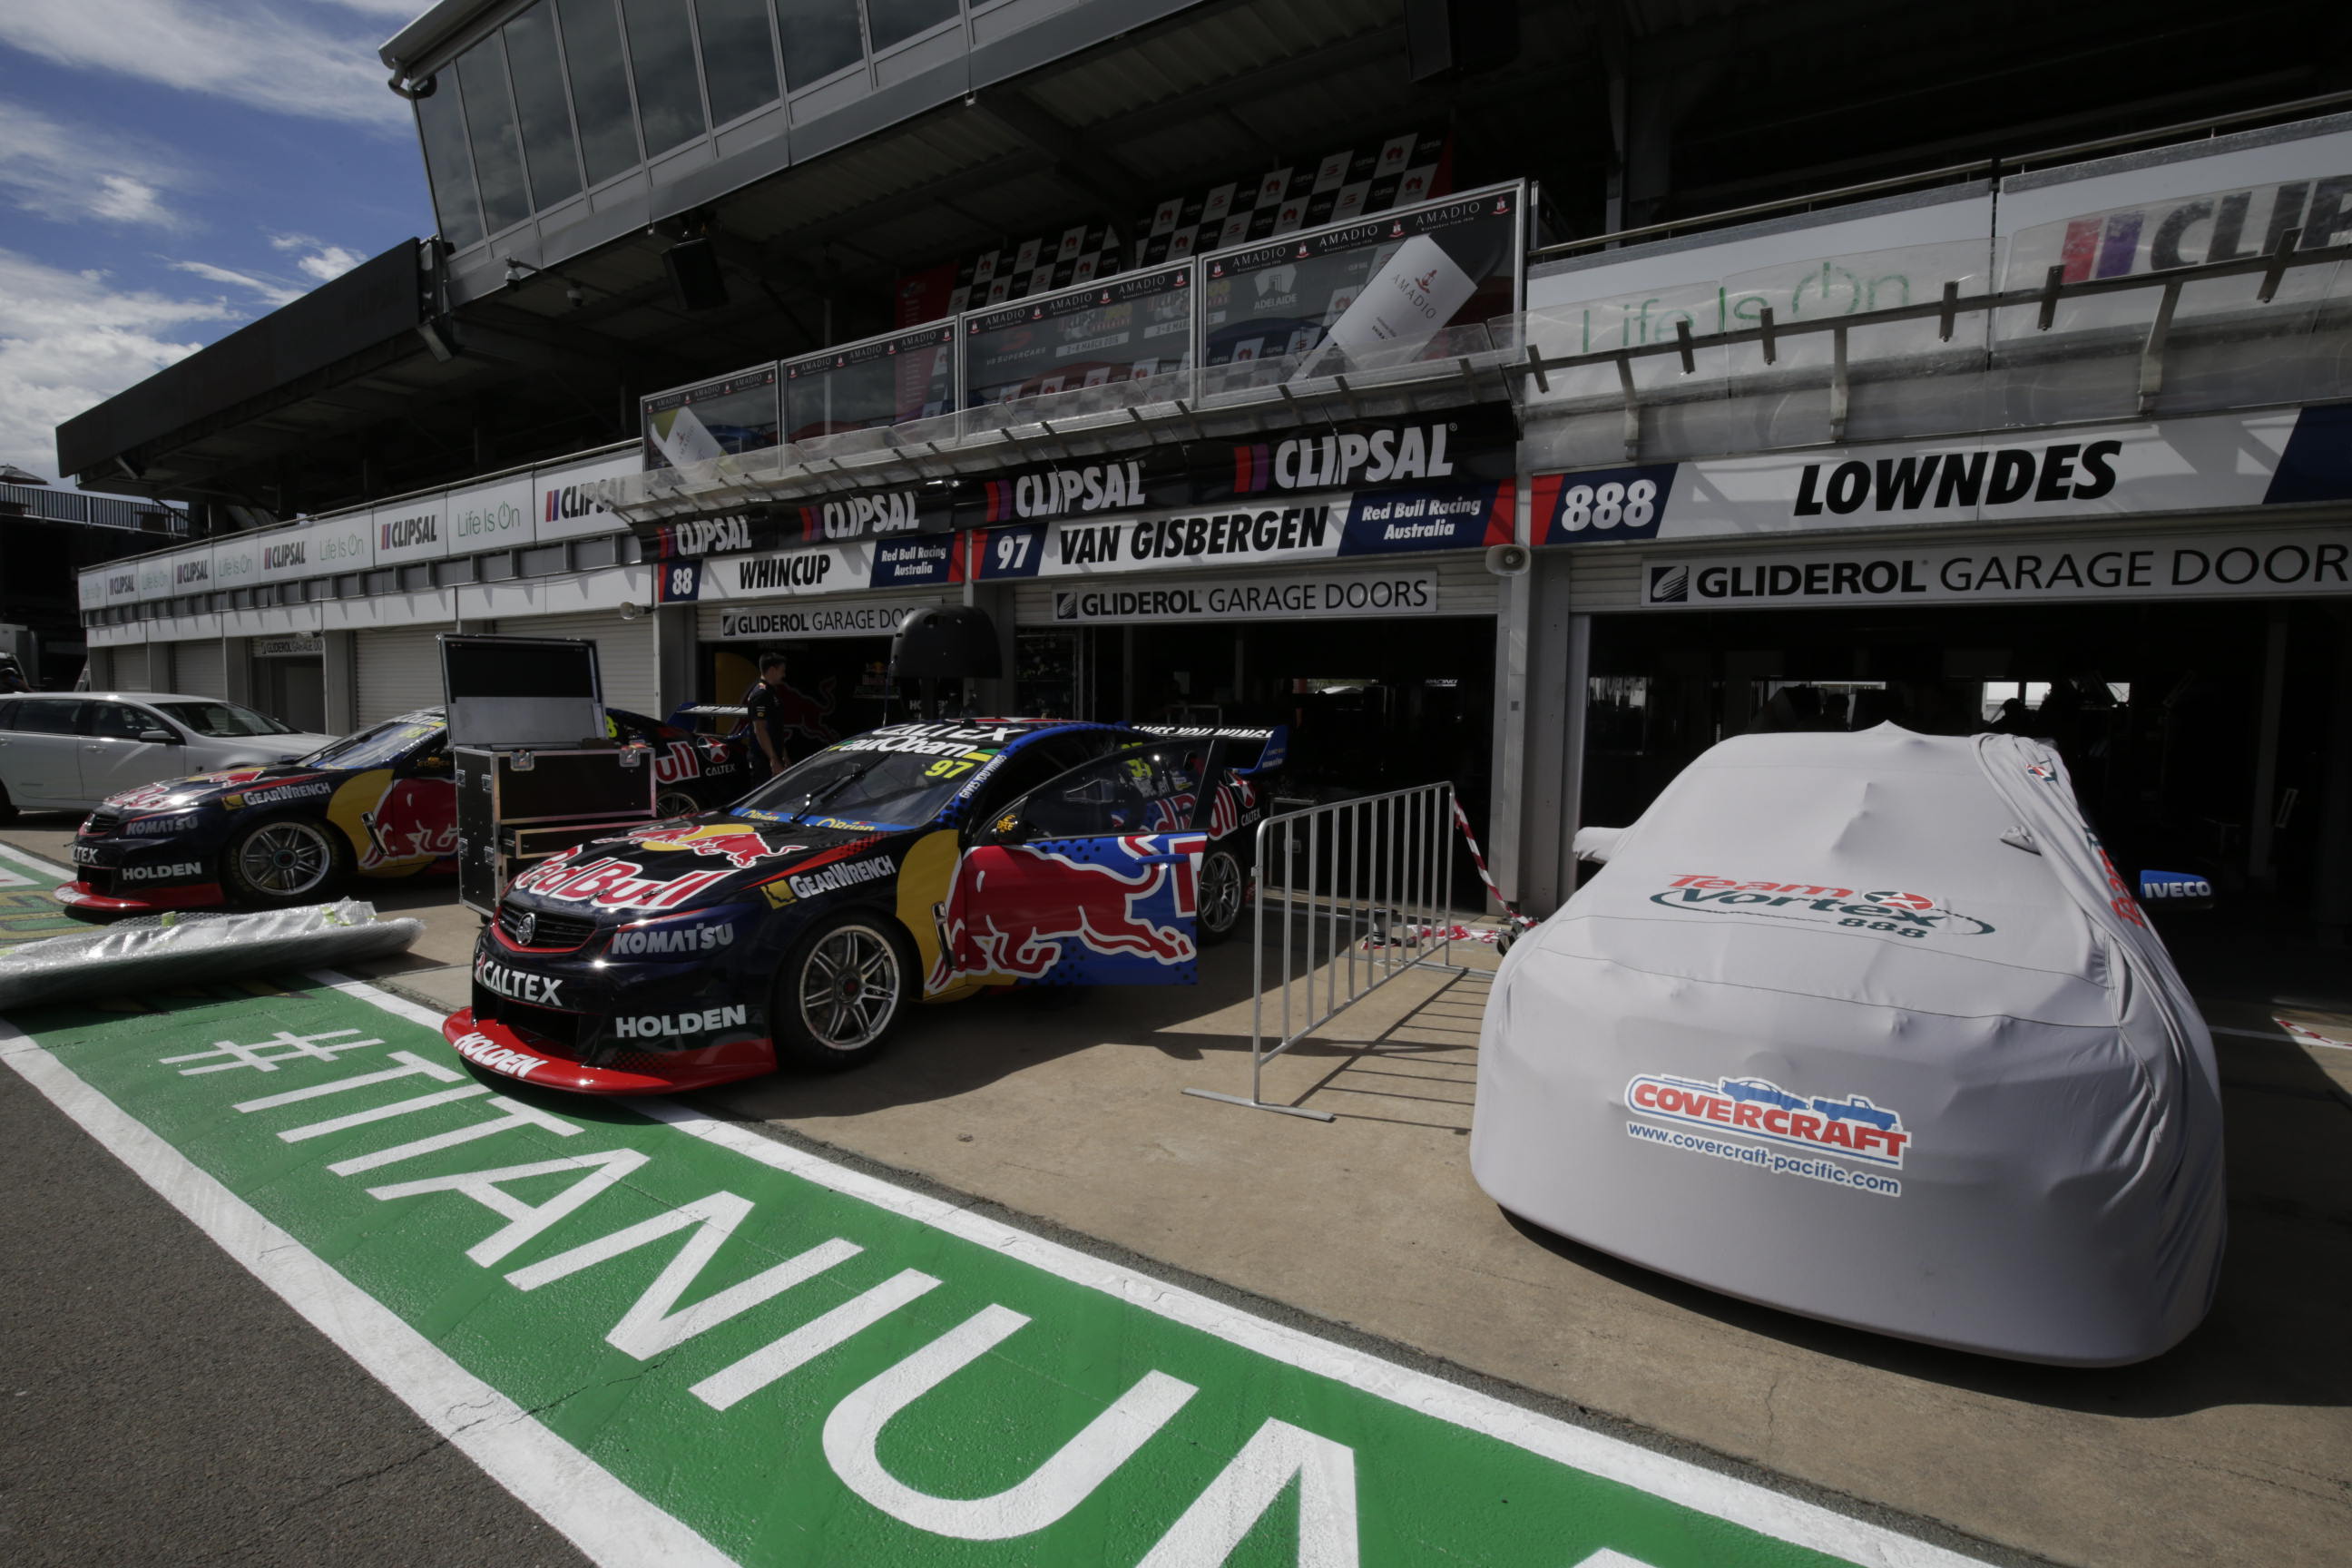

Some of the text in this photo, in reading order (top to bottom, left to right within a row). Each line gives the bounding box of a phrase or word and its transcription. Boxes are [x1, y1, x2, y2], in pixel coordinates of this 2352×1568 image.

[1416, 201, 1480, 226] AMADIO
[1319, 225, 1378, 248] AMADIO
[1232, 247, 1287, 268] AMADIO
[1119, 276, 1166, 296] AMADIO
[1394, 274, 1437, 319] AMADIO
[1049, 293, 1093, 310] AMADIO
[1254, 293, 1298, 309] ADELAIDE
[985, 309, 1025, 326] AMADIO
[849, 345, 882, 359] AMADIO
[901, 331, 936, 348] AMADIO
[800, 357, 831, 371] AMADIO
[1274, 423, 1454, 489] CLIPSAL
[1014, 460, 1145, 519] CLIPSAL
[1793, 440, 2122, 517] LOWNDES
[823, 491, 920, 539] CLIPSAL
[1362, 497, 1482, 523] Red Bull Racing
[1561, 478, 1658, 533] 888
[391, 514, 437, 548] CLIPSAL
[457, 509, 481, 537] Life
[484, 510, 495, 533] Is
[675, 514, 752, 555] CLIPSAL
[1060, 505, 1330, 565] VAN GISBERGEN
[1384, 520, 1455, 541] Australia
[272, 541, 306, 568] CLIPSAL
[881, 545, 946, 563] Red Bull Racing
[996, 533, 1033, 570] 97
[182, 559, 208, 583] CLIPSAL
[672, 567, 693, 594] 88
[739, 554, 831, 590] WHINCUP
[894, 561, 933, 577] Australia
[1696, 544, 2349, 598] GLIDEROL GARAGE DOOR
[1082, 579, 1428, 616] GLIDEROL GARAGE DOORS
[738, 611, 809, 635] GLIDEROL
[812, 609, 876, 632] GARAGE
[871, 723, 1026, 741] CALTEX
[705, 763, 736, 777] CALTEX
[924, 760, 975, 779] 97
[959, 780, 980, 799] GIVES
[126, 816, 199, 836] KOMATSU
[122, 861, 202, 881] HOLDEN
[1669, 874, 1854, 898] Team
[2143, 881, 2213, 898] IVECO
[1676, 887, 1946, 928] Vortex
[611, 922, 735, 956] KOMATSU
[1837, 917, 1929, 939] 888
[482, 959, 564, 1006] CALTEX
[616, 1004, 748, 1039] HOLDEN
[453, 1032, 549, 1078] HOLDEN
[1634, 1083, 1907, 1157] COVERCRAFT
[1629, 1122, 1899, 1194] www.covercraft-pacific.com
